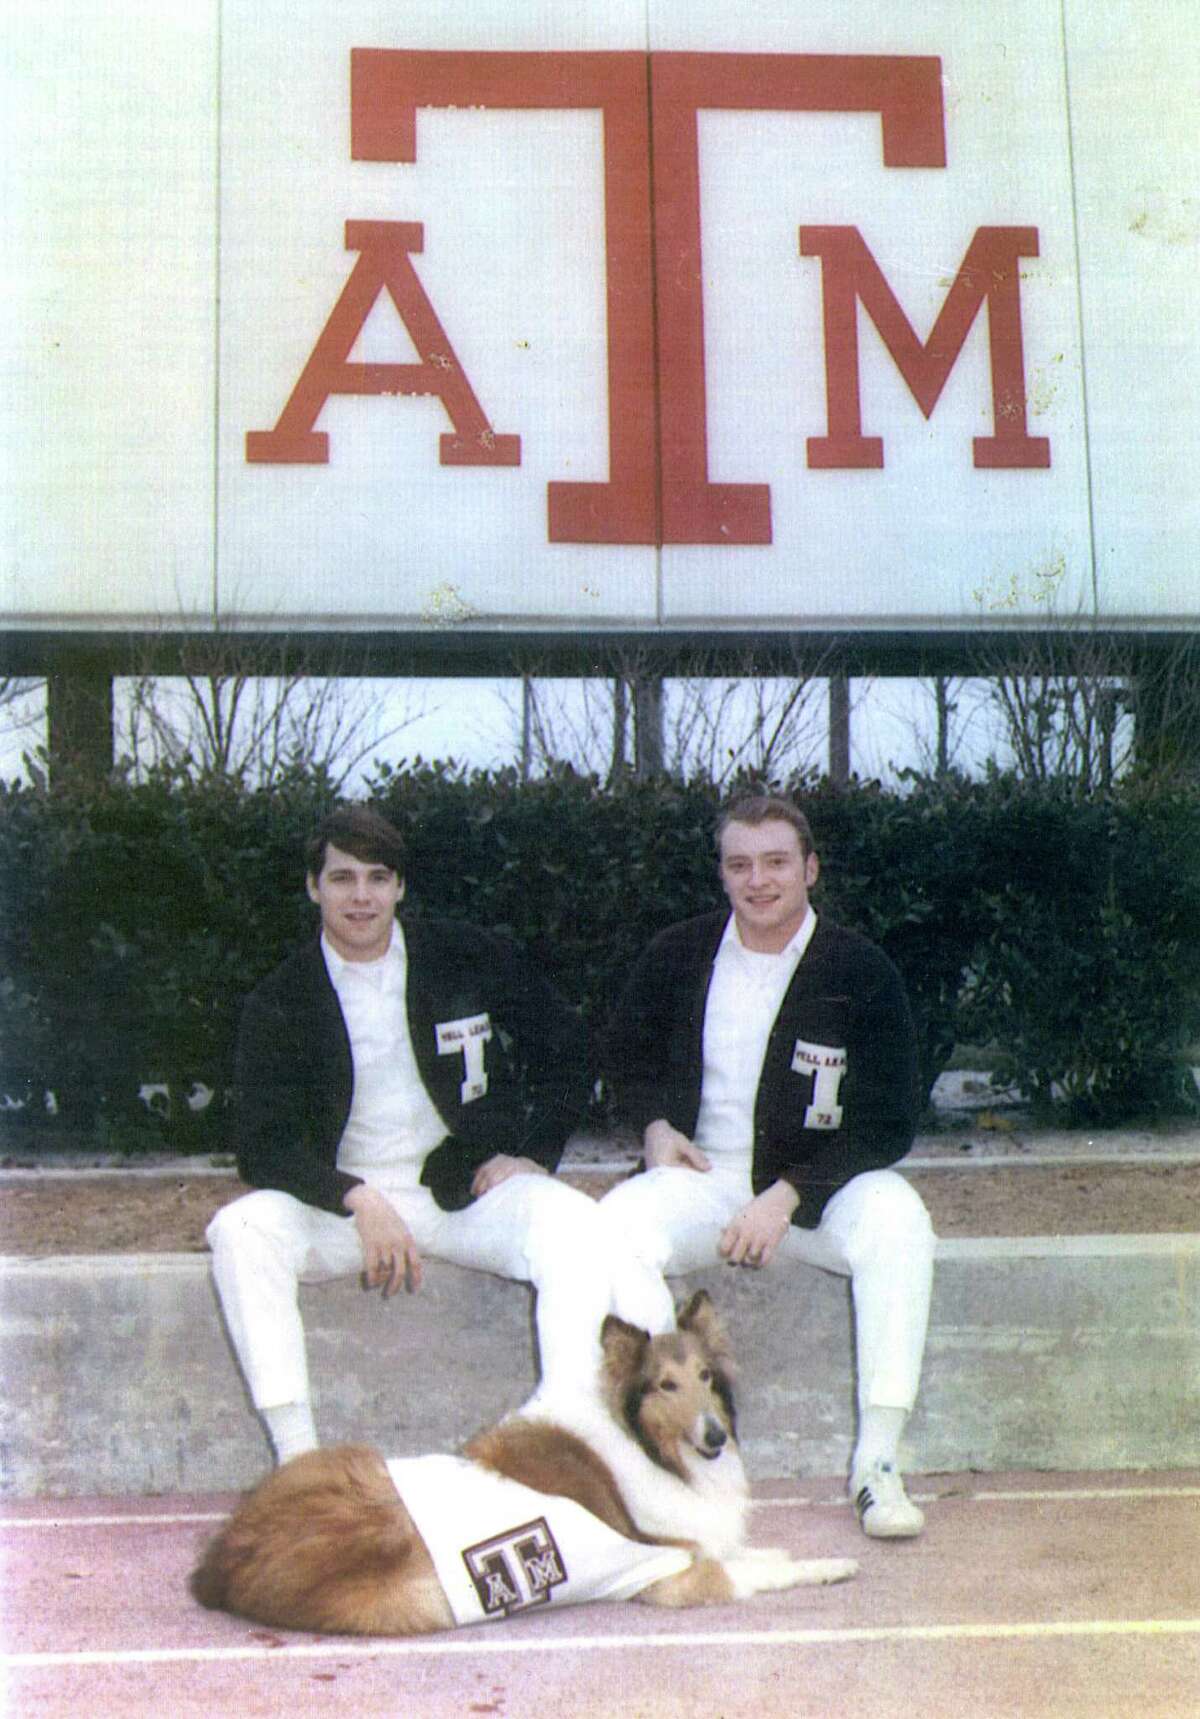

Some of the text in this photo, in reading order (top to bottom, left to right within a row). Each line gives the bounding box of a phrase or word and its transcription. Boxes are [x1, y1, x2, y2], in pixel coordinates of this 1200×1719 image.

[442, 1029, 465, 1042] YELL
[797, 1050, 821, 1066] YELL
[817, 1113, 832, 1125] 72
